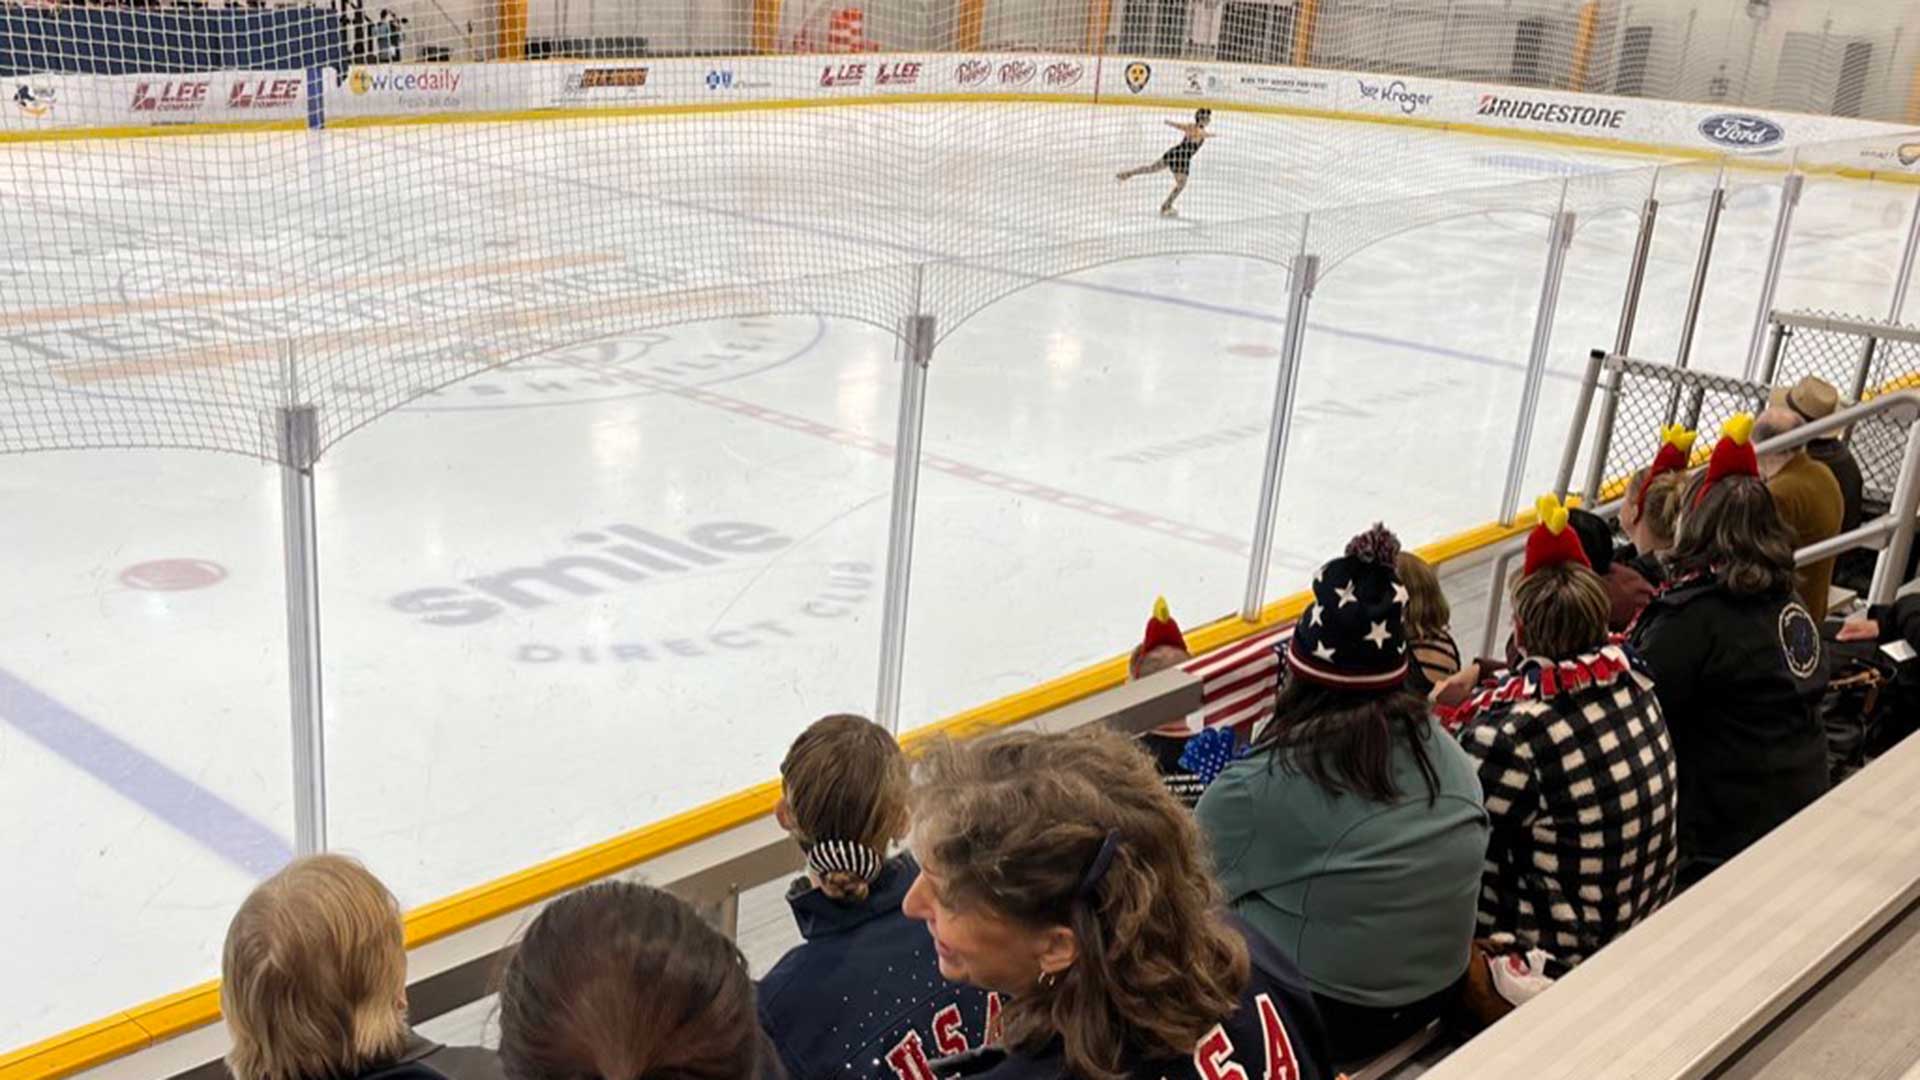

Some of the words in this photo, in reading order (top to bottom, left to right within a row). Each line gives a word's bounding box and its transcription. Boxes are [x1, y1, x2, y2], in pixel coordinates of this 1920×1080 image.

[161, 80, 209, 101] LEE
[255, 79, 302, 99] LEE
[1382, 81, 1433, 113] Kroger
[1477, 94, 1627, 129] BRIDGESTONE
[1714, 119, 1768, 142] Ford
[390, 521, 795, 627] smile
[514, 619, 796, 664] DIRECT
[799, 560, 875, 619] CLUB
[1193, 993, 1300, 1080] SA
